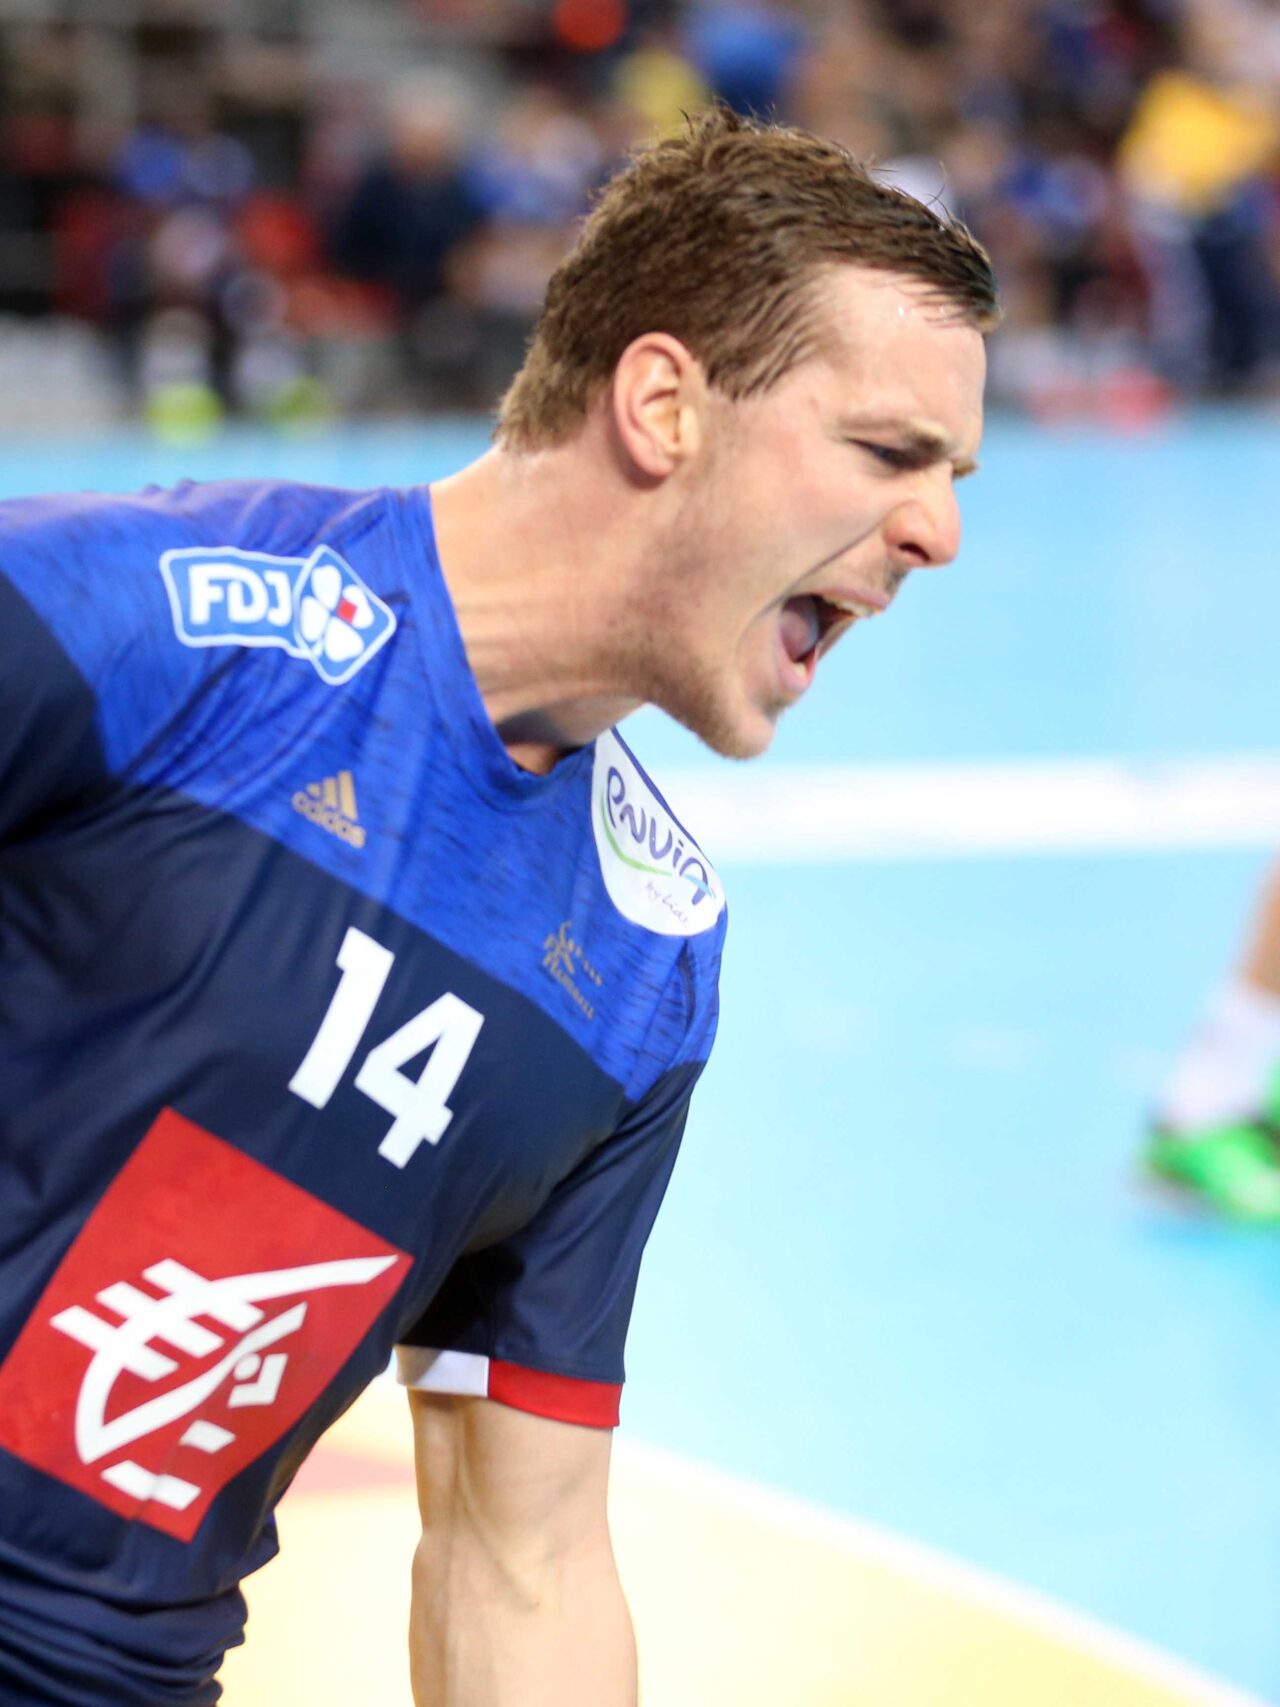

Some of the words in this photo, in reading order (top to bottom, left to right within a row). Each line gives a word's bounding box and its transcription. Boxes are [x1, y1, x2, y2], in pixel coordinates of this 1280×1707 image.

[187, 562, 294, 627] FDJ
[291, 790, 368, 850] adidas
[287, 925, 485, 1170] 14
